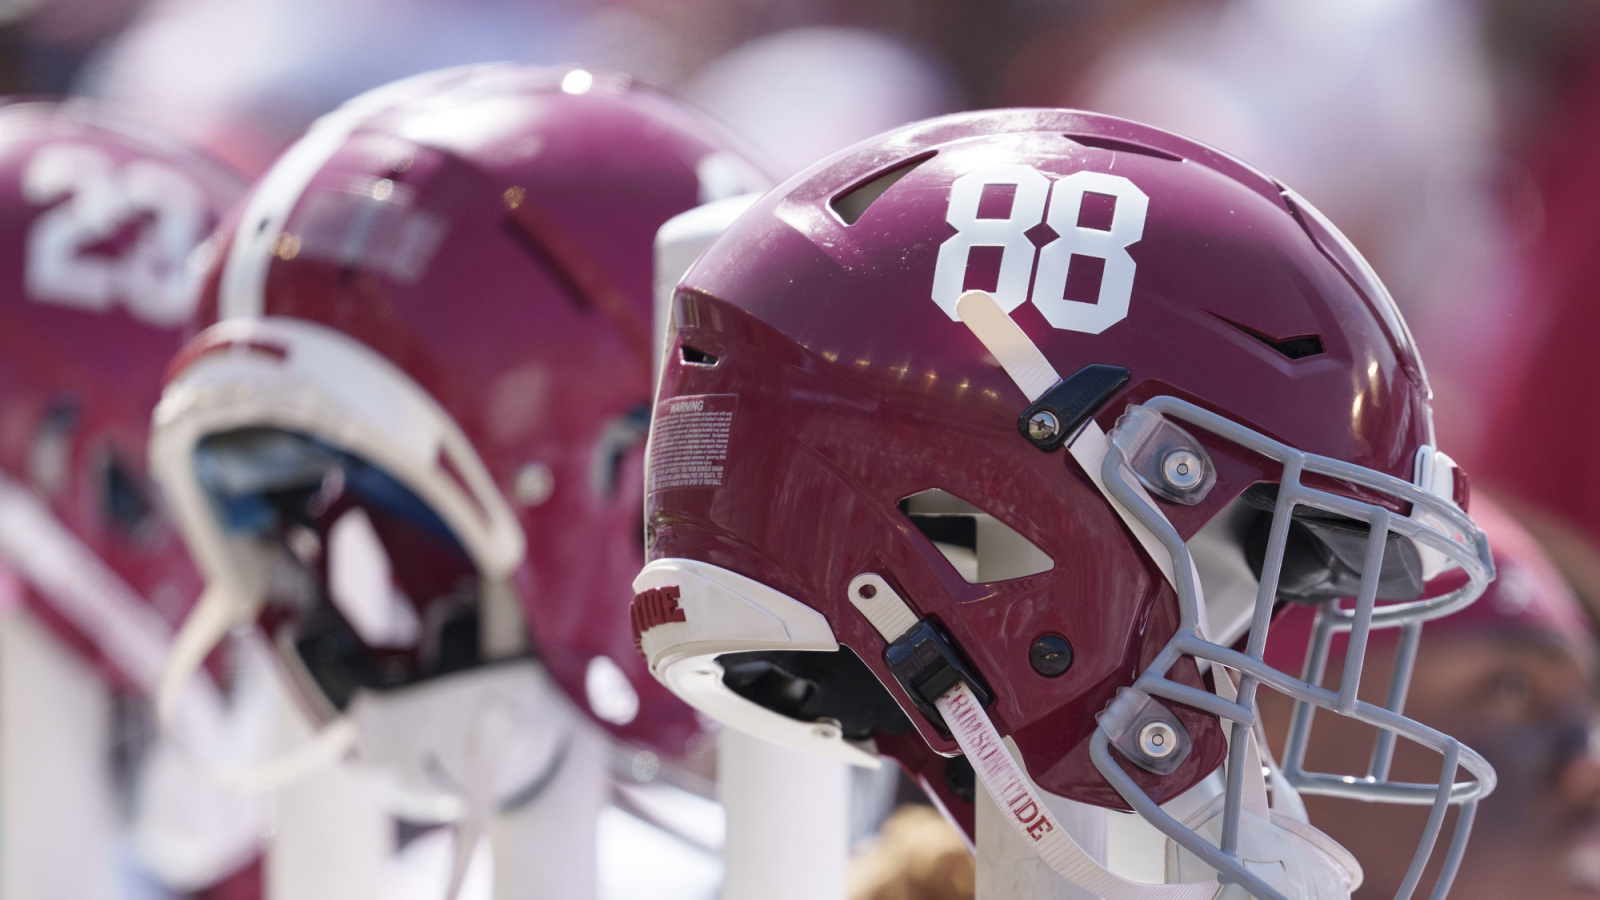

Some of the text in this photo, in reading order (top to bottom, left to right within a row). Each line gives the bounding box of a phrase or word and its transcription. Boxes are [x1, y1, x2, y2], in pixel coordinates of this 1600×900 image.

[931, 164, 1150, 334] 88
[670, 400, 704, 413] WARNING
[1001, 773, 1054, 842] TIDE
